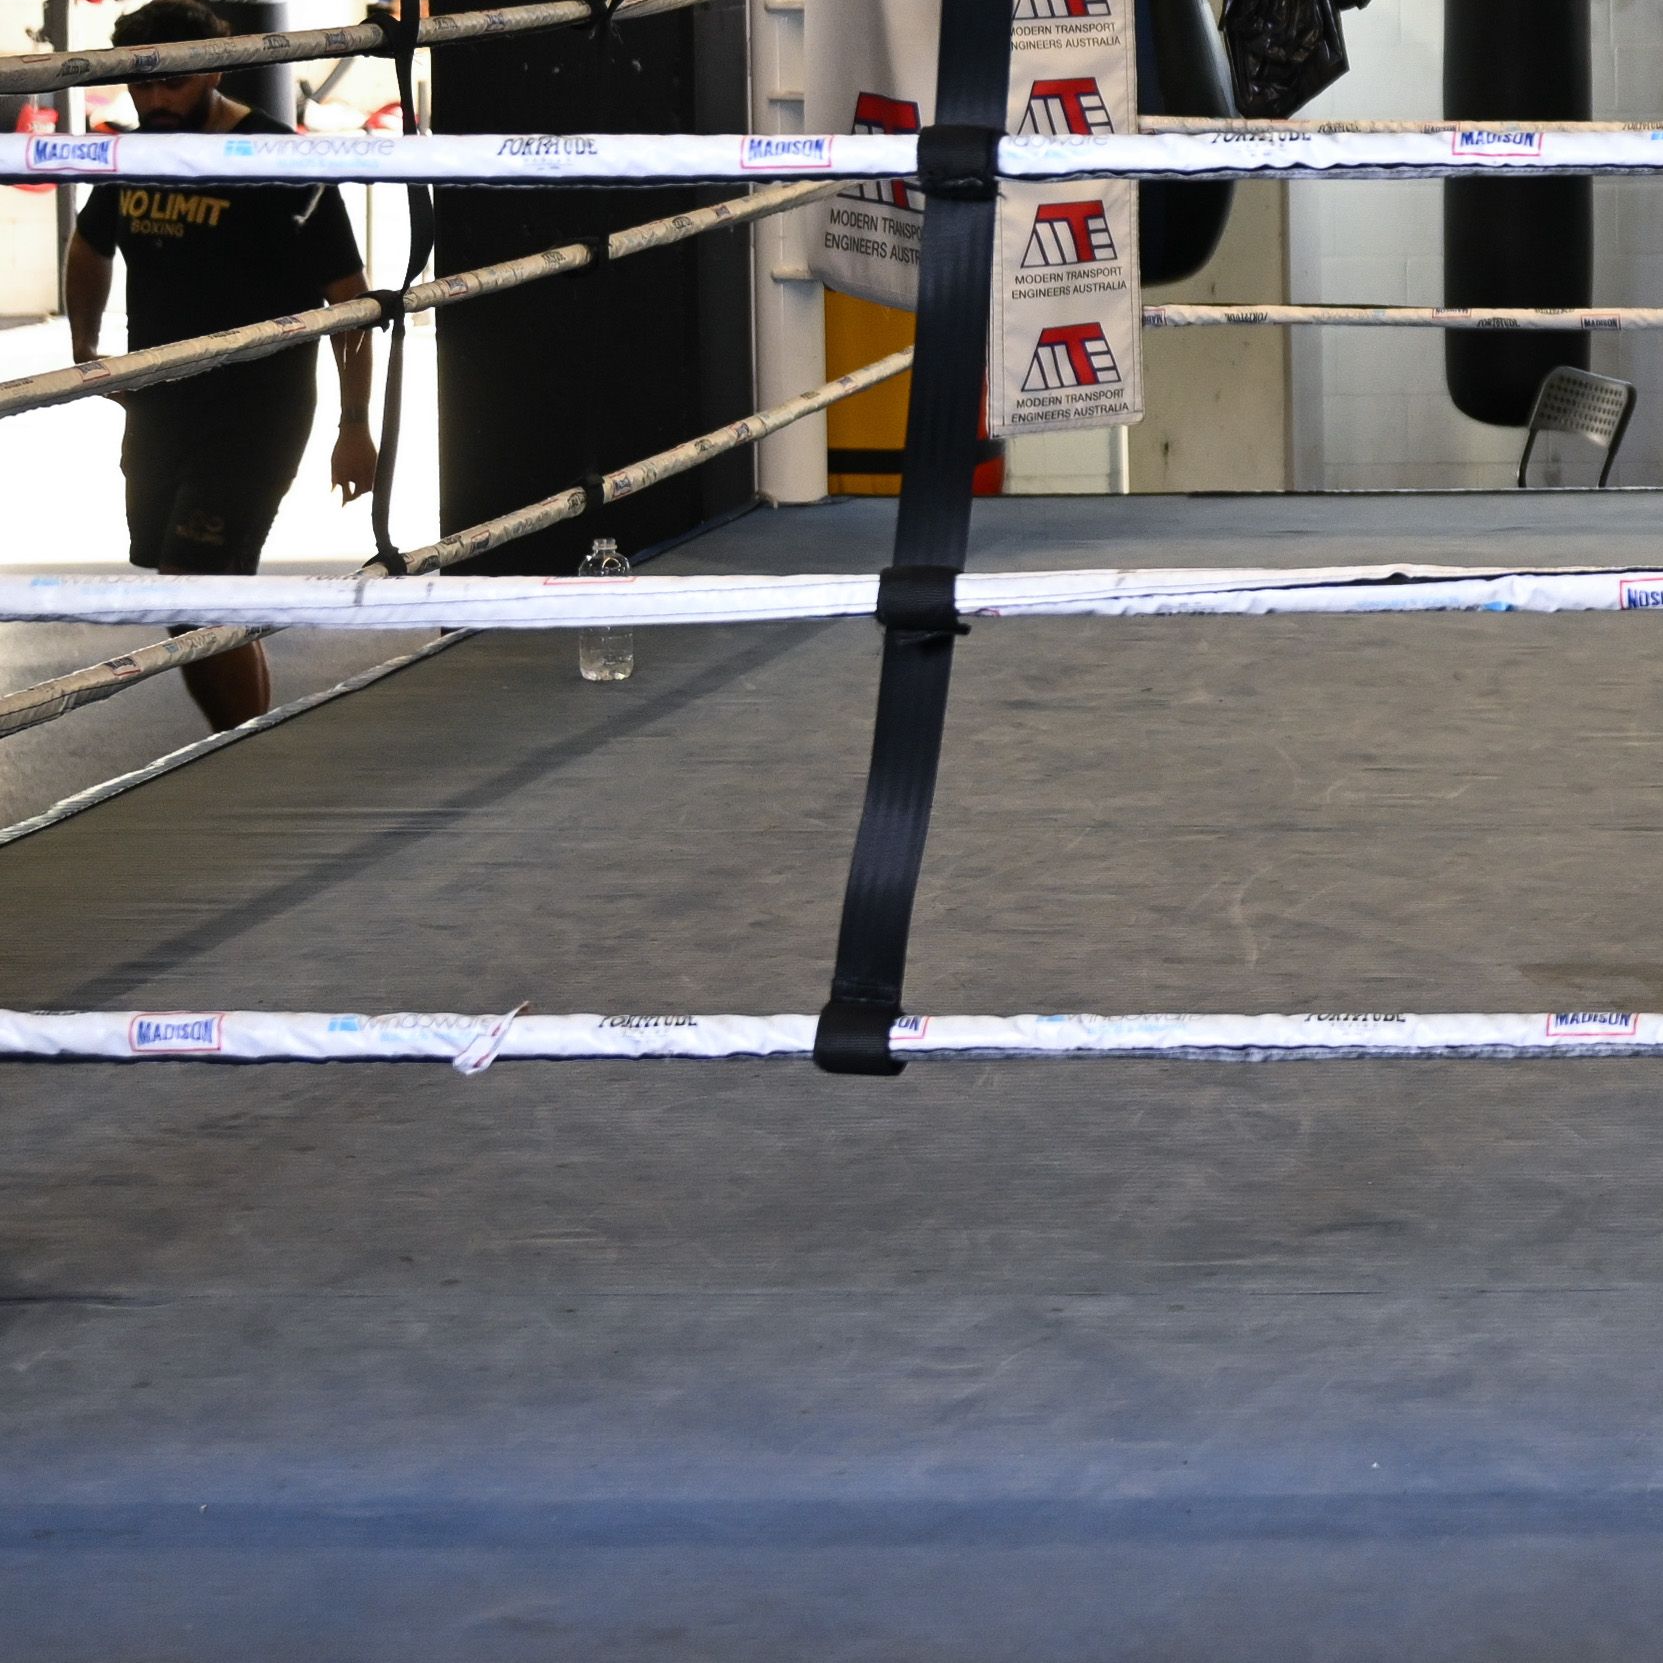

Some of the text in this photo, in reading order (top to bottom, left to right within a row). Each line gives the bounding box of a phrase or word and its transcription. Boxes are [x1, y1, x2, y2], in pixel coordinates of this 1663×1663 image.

[1056, 22, 1116, 34] TRANSPORT
[1010, 35, 1121, 49] NGINEERS AUSTRALIA
[748, 137, 824, 161] MADISON
[1460, 131, 1535, 148] MADISON
[34, 140, 110, 165] MADISON
[151, 192, 231, 226] LIMIT
[830, 209, 922, 240] MODERN TRANSP
[825, 236, 920, 264] ENGINEERS AUSTR
[1015, 268, 1122, 285] MODERN TRANSPORT
[1012, 281, 1127, 300] ENGINEERS AUSTRALIA
[1016, 389, 1125, 409] MODERN TRANSPORT
[1012, 402, 1129, 424] ENGINEERS AUSTRALIA
[137, 1019, 213, 1047] MADISON
